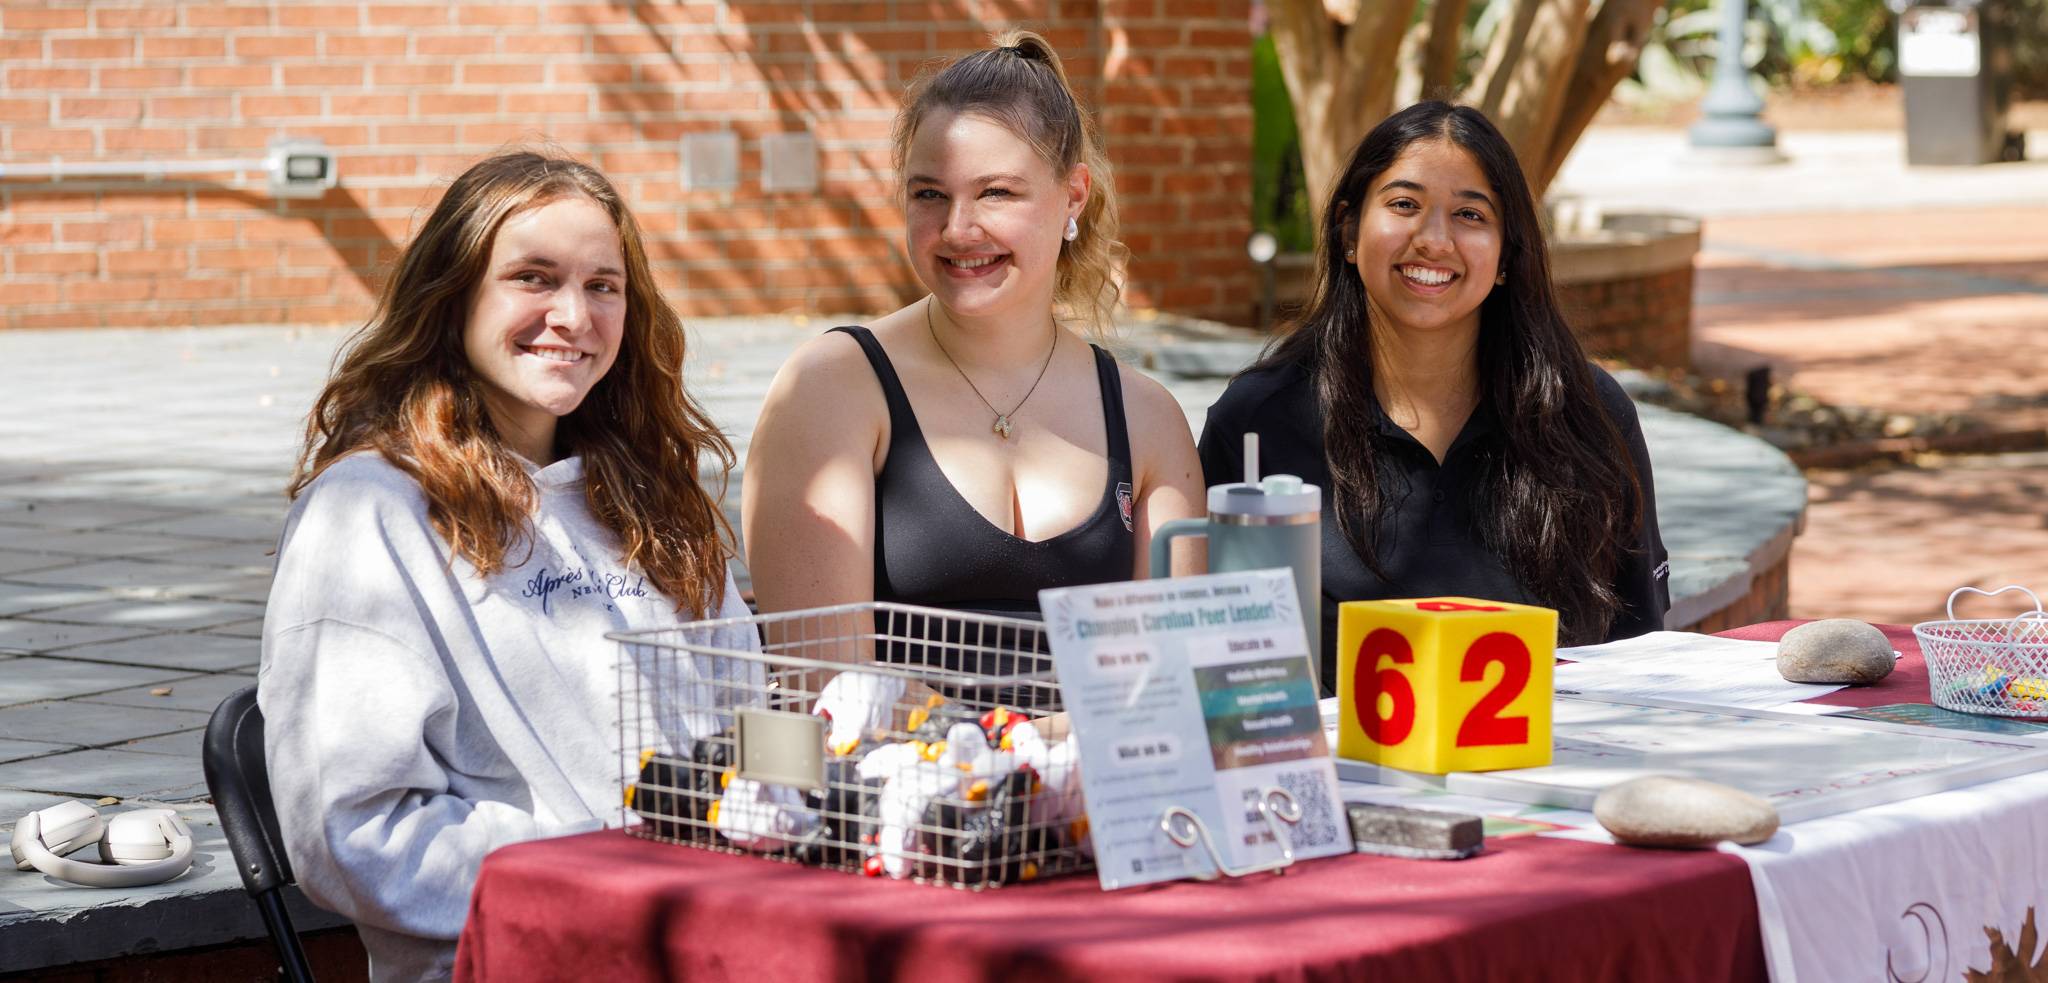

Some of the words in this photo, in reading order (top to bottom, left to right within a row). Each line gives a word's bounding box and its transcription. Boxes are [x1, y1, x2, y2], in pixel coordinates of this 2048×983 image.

[522, 567, 583, 616] Après
[605, 572, 649, 599] Club
[1076, 613, 1140, 640] Changing
[1142, 608, 1196, 633] Carolina
[1197, 605, 1227, 626] Peer
[1228, 599, 1276, 624] Leader!
[1354, 627, 1415, 747] 6
[1456, 631, 1532, 748] 2
